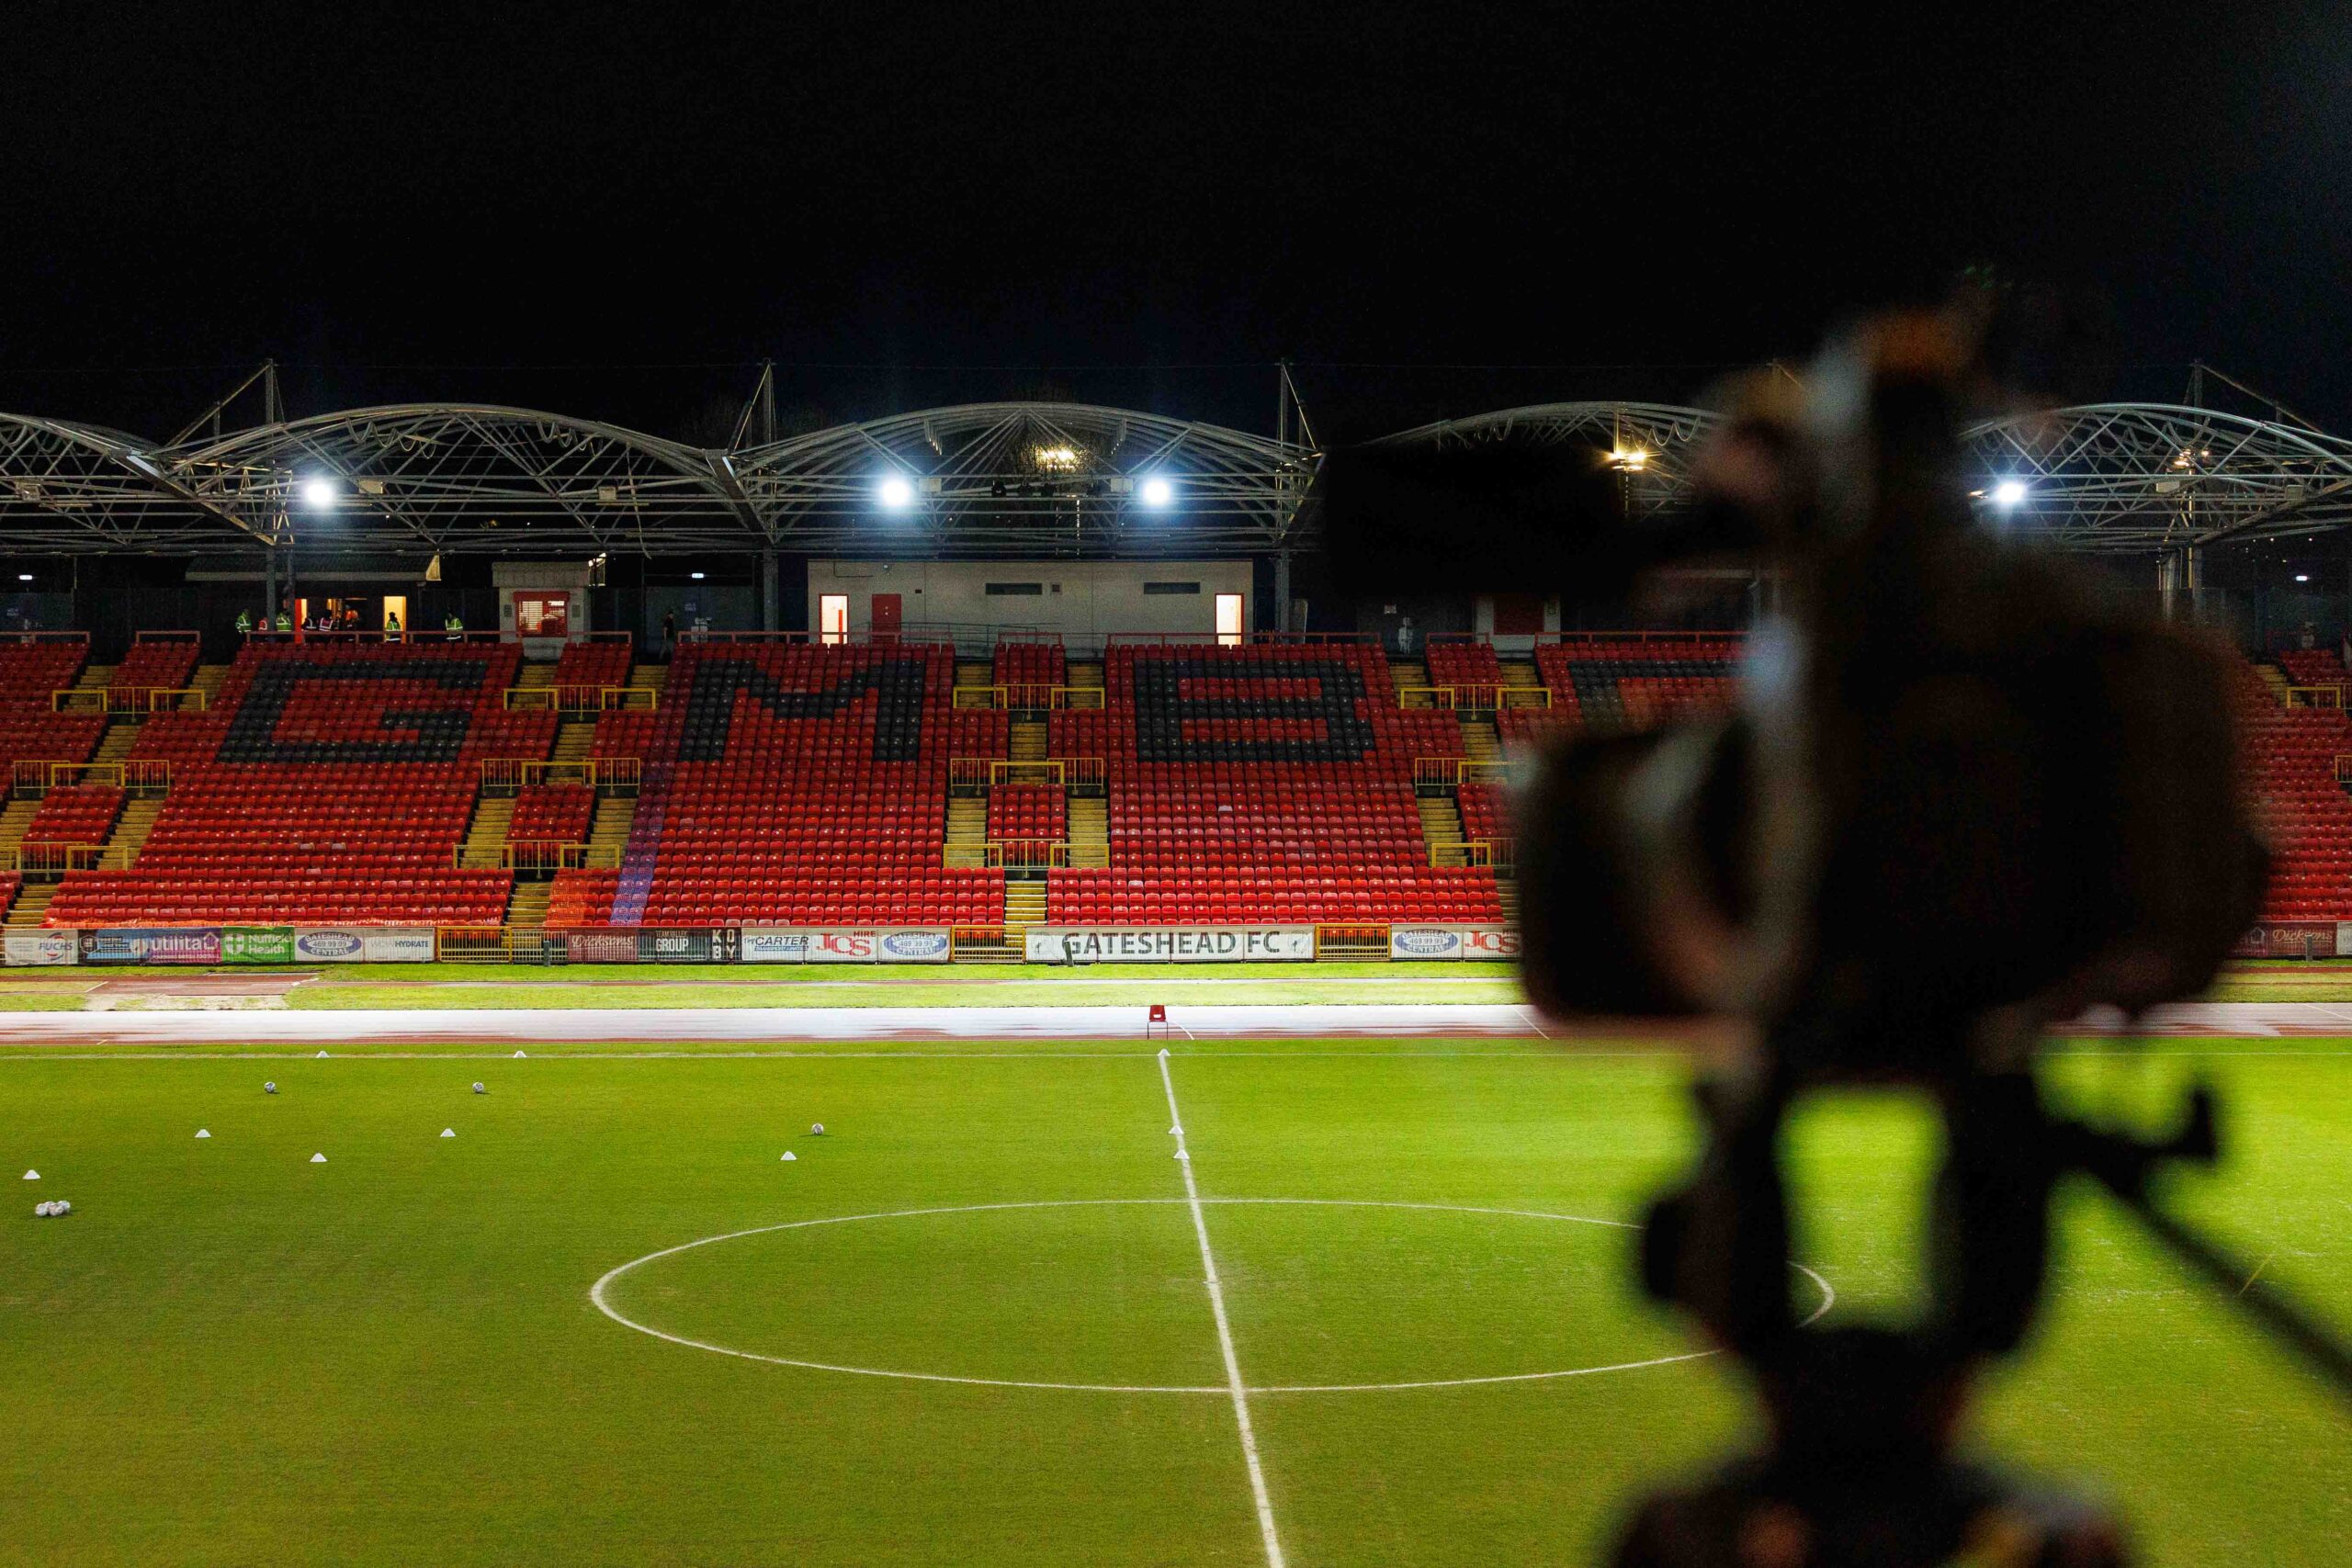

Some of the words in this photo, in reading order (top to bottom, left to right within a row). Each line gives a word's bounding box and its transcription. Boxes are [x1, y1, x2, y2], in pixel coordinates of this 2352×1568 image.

[305, 931, 355, 942] GATESHEAD
[656, 930, 669, 938] TEAM
[670, 930, 687, 938] VALLEY
[152, 935, 202, 951] utilita
[656, 938, 689, 952] GROUP
[755, 936, 809, 946] CARTER
[816, 932, 872, 956] JCS
[1062, 932, 1236, 954] GATESHEAD
[1248, 931, 1281, 953] FC
[1464, 930, 1521, 954] JCS
[39, 942, 74, 951] FUCHS
[248, 944, 285, 954] Health
[311, 947, 349, 956] CENTRAL
[896, 947, 936, 955] CENTRAL
[1407, 944, 1446, 953] CENTRAL
